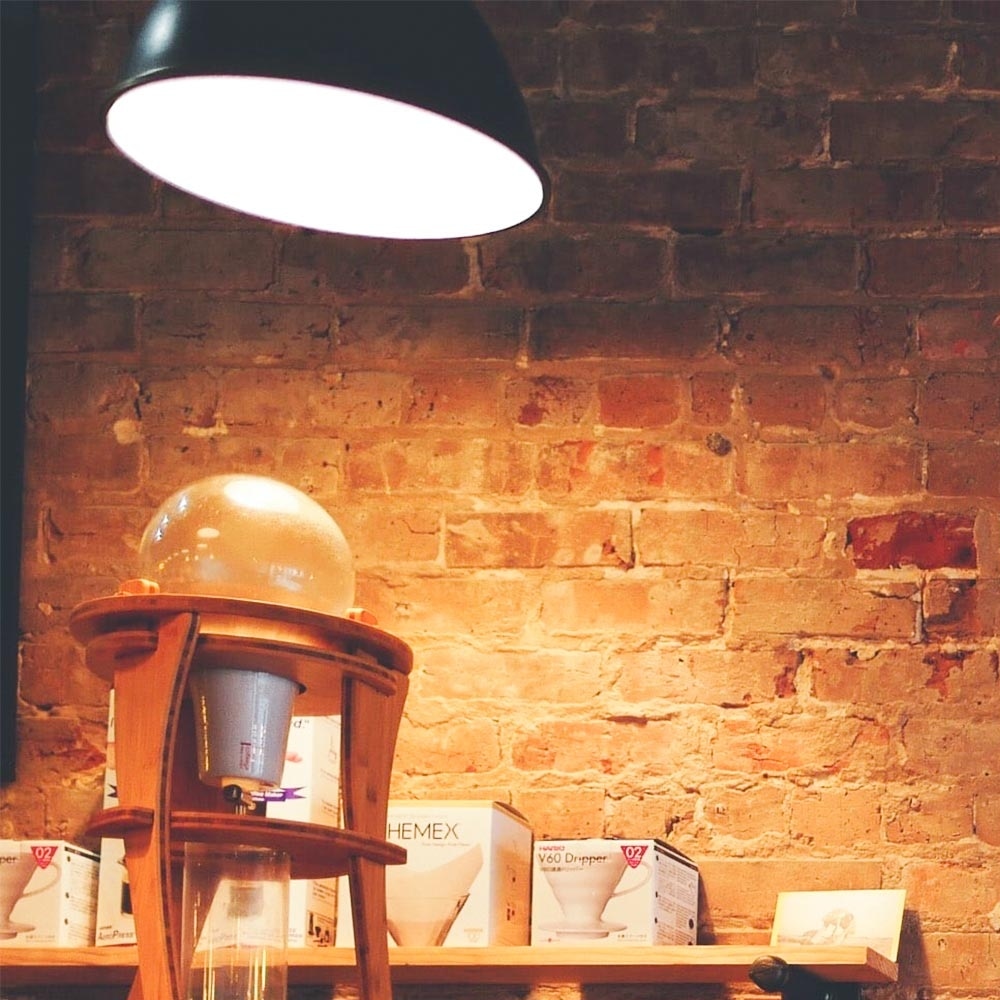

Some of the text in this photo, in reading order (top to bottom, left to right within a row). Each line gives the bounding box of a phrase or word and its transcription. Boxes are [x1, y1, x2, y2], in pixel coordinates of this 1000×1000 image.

[388, 823, 460, 840] HEMEX
[35, 847, 52, 859] 02
[625, 846, 642, 858] 02
[537, 852, 608, 866] V60 Dripper
